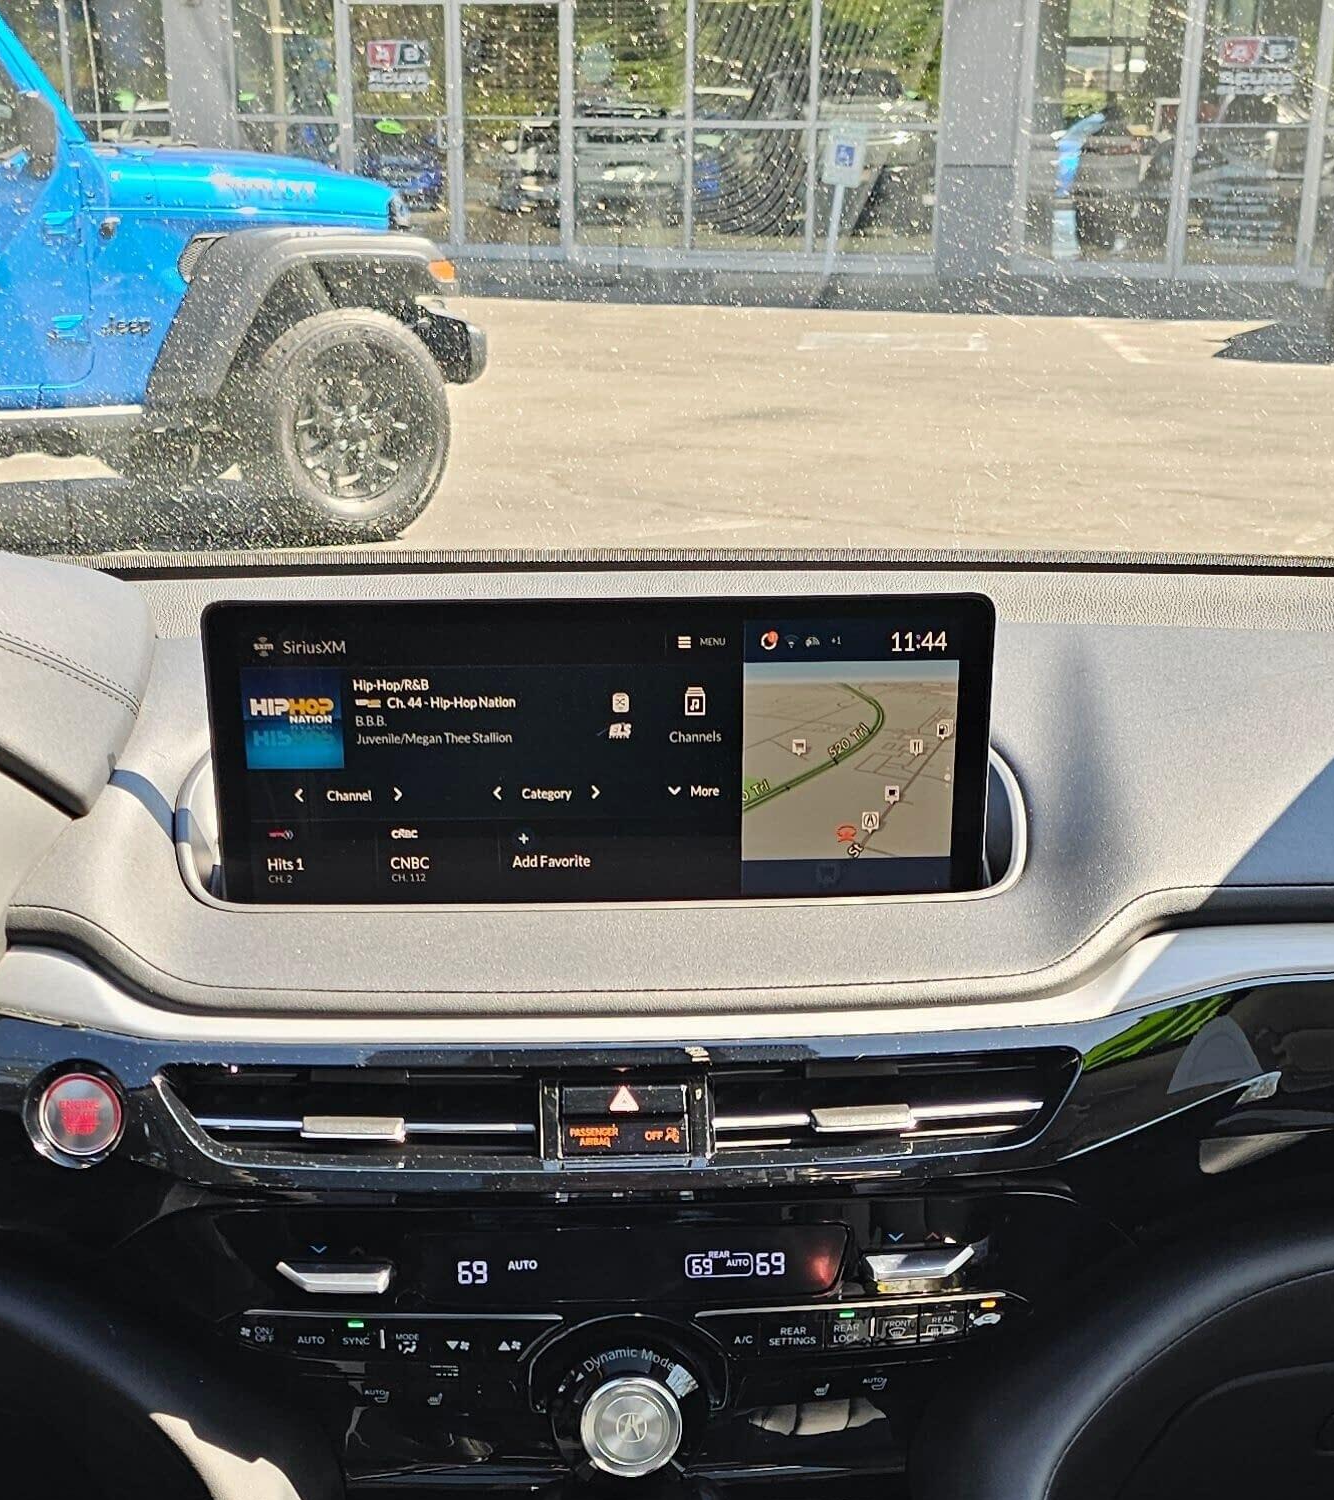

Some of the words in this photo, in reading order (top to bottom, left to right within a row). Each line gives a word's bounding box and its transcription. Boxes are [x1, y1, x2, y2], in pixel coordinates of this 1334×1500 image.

[100, 316, 152, 335] Jeep
[699, 637, 726, 647] MENU
[890, 631, 948, 652] 11:44
[282, 640, 347, 655] SiriusXM
[352, 678, 430, 692] Hip-Hop/R&B
[386, 697, 407, 709] Ch.
[407, 697, 423, 709] 44
[430, 697, 478, 711] Hip-Hop
[478, 696, 517, 709] Nation
[289, 714, 333, 724] NATION
[355, 716, 388, 727] B.B.B.
[355, 733, 442, 747] Juvenile/Megan
[443, 732, 471, 745] Thee
[472, 732, 513, 744] Stallion
[668, 731, 722, 744] Channels
[827, 739, 851, 759] 520
[851, 722, 870, 740] Trl
[326, 789, 373, 802] Channel
[521, 787, 573, 802] Category
[690, 785, 721, 797] More
[267, 858, 295, 871] Hits
[296, 858, 305, 871] 1
[390, 856, 430, 870] CNBC
[512, 855, 538, 868] Add
[539, 854, 591, 868] Favorite
[286, 874, 293, 884] 2
[391, 873, 409, 883] CH.
[409, 872, 427, 883] 112
[569, 1126, 619, 1137] PASSENGER
[644, 1130, 664, 1141] OFF
[708, 1250, 730, 1259] REAR
[507, 1259, 538, 1272] AUTO
[691, 1258, 713, 1275] 69
[726, 1258, 750, 1267] AUTO
[755, 1252, 785, 1275] 69
[457, 1260, 488, 1284] 69
[885, 1319, 912, 1328] FRONT
[931, 1315, 955, 1324] REAR
[780, 1327, 807, 1337] REAR
[833, 1324, 860, 1334] REAR
[254, 1335, 275, 1343] OFF
[297, 1335, 325, 1345] AUTO
[342, 1336, 371, 1346] SYNC
[395, 1333, 419, 1341] MODE
[734, 1335, 754, 1345] A/C
[768, 1336, 817, 1347] SETTINGS
[833, 1333, 860, 1344] LOCK
[582, 1346, 638, 1372] Dynamic
[641, 1348, 675, 1371] Mode
